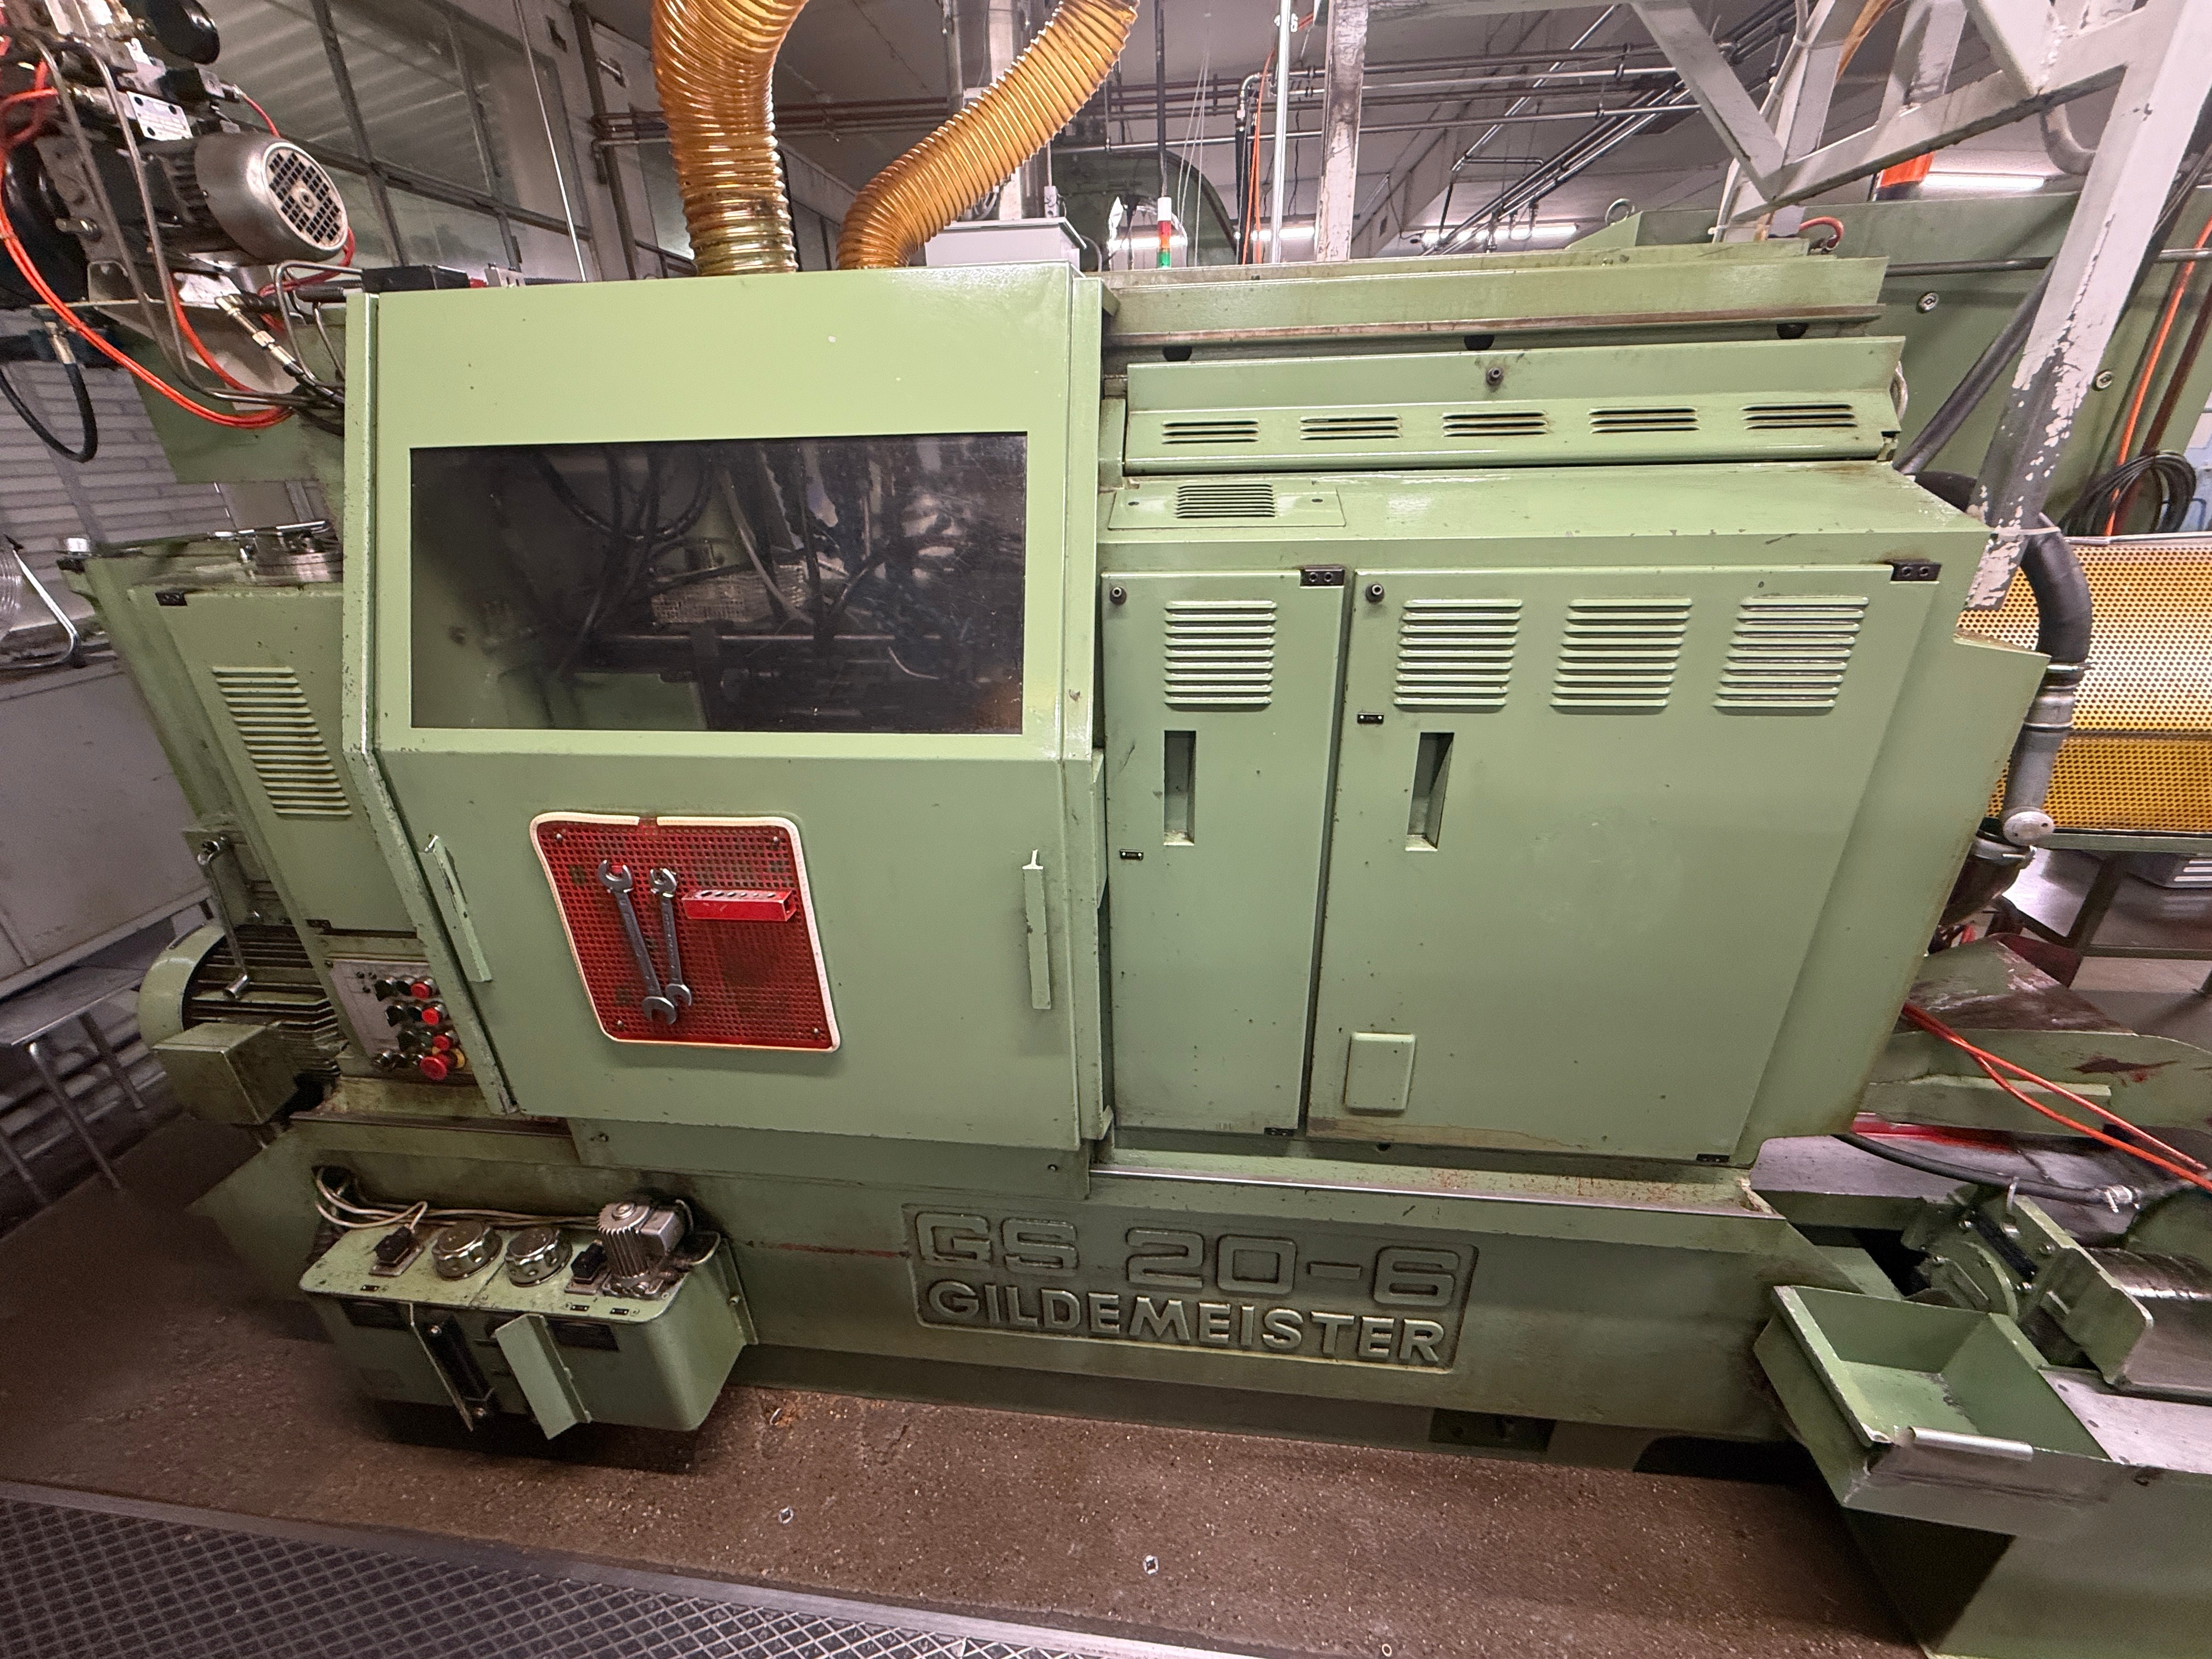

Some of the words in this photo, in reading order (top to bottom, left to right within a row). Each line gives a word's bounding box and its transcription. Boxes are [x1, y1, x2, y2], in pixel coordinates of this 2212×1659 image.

[916, 1211, 1080, 1274] GS
[1125, 1227, 1462, 1306] 20-6
[928, 1280, 1447, 1362] GILDEMEISTER
